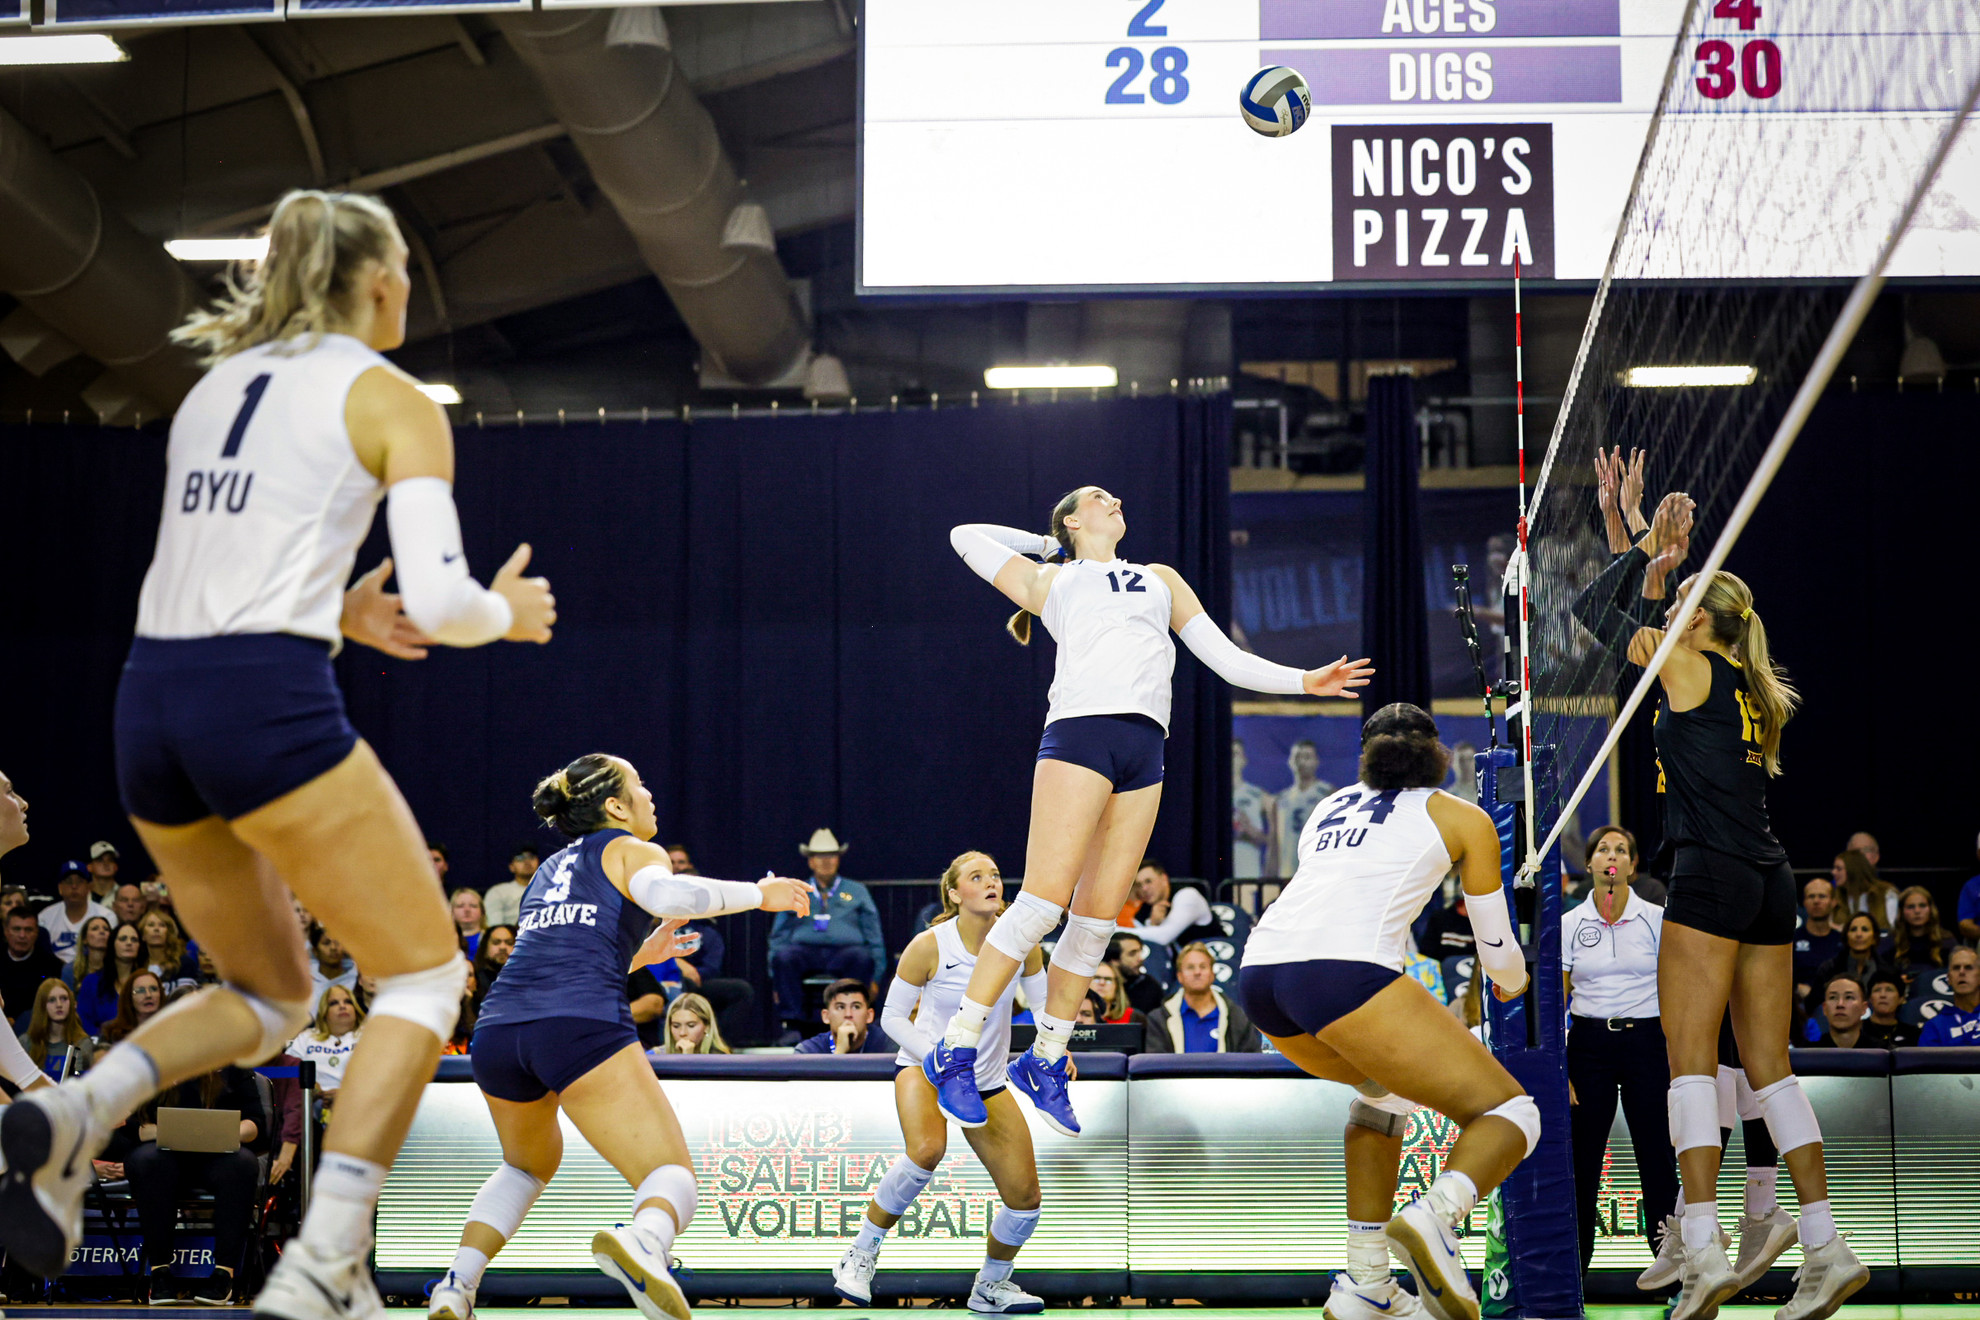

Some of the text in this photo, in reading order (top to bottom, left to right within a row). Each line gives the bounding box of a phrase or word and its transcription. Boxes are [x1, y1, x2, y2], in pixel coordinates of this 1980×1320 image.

[1127, 0, 1167, 37] 2
[1382, 0, 1497, 34] ACES
[1105, 39, 1782, 105] 28 DIGS 30
[1352, 137, 1532, 197] NICO'S
[1353, 207, 1533, 267] PIZZA
[221, 373, 273, 458] 1
[181, 471, 253, 514] BYU
[1106, 569, 1146, 593] 12
[1317, 789, 1401, 832] 24
[1315, 828, 1368, 852] BYU
[543, 853, 579, 903] 5
[720, 1154, 951, 1192] SALT LAE
